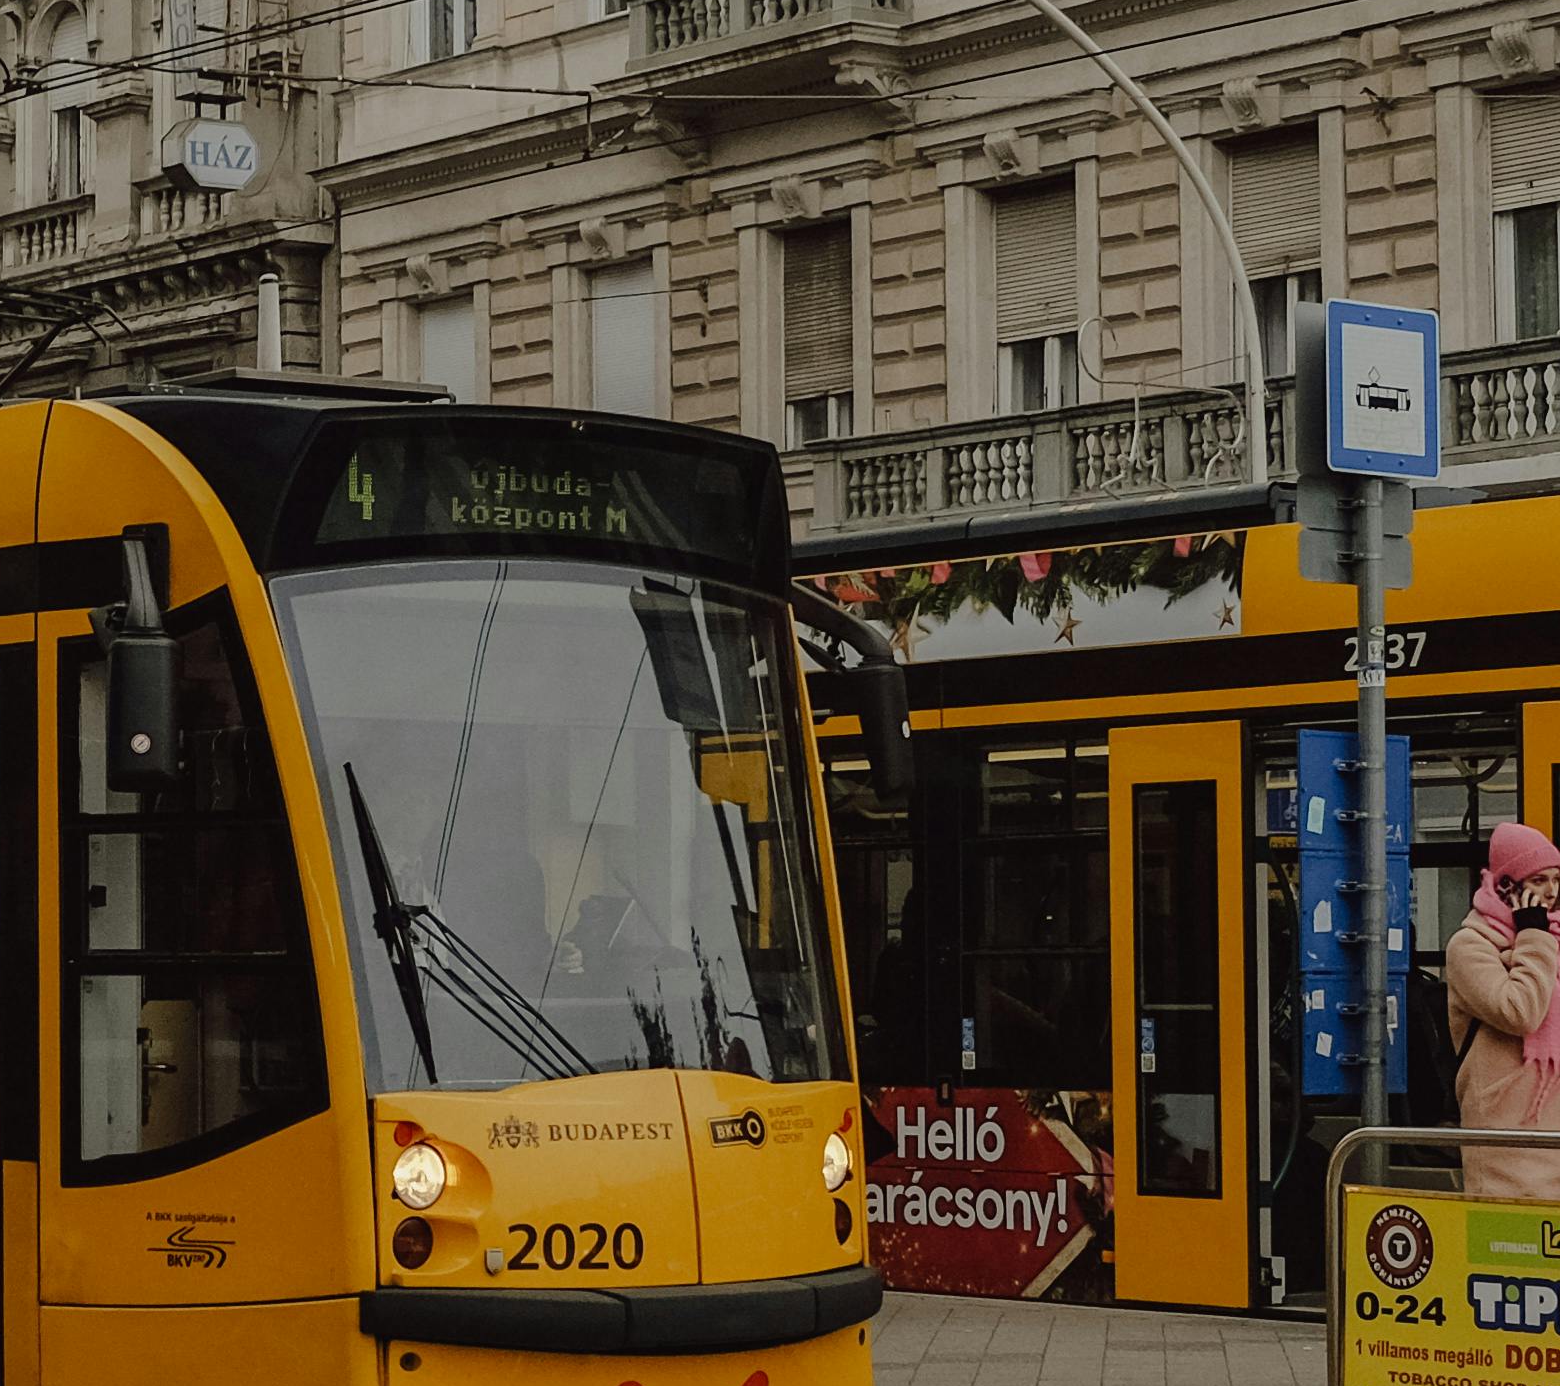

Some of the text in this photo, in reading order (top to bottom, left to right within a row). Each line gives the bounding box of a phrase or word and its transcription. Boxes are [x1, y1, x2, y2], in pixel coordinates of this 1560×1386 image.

[187, 134, 253, 171] HÁZ
[347, 451, 376, 521] 4
[451, 496, 628, 534] központ M
[1343, 631, 1427, 673] 237
[547, 1121, 675, 1143] BUDAPEST
[715, 1122, 744, 1140] BKK
[896, 1105, 1006, 1163] Helló
[145, 1212, 153, 1222] A
[155, 1212, 172, 1222] BKK
[230, 1215, 236, 1223] a
[1376, 1207, 1423, 1229] NEMZETI
[166, 1253, 194, 1268] BKV
[506, 1222, 645, 1271] 2020
[1369, 1252, 1430, 1287] DOHÁNYBOLT
[1355, 1292, 1447, 1327] 0-24
[1355, 1338, 1363, 1355] 1
[1367, 1340, 1429, 1361] villamos
[1433, 1347, 1494, 1369] megálló
